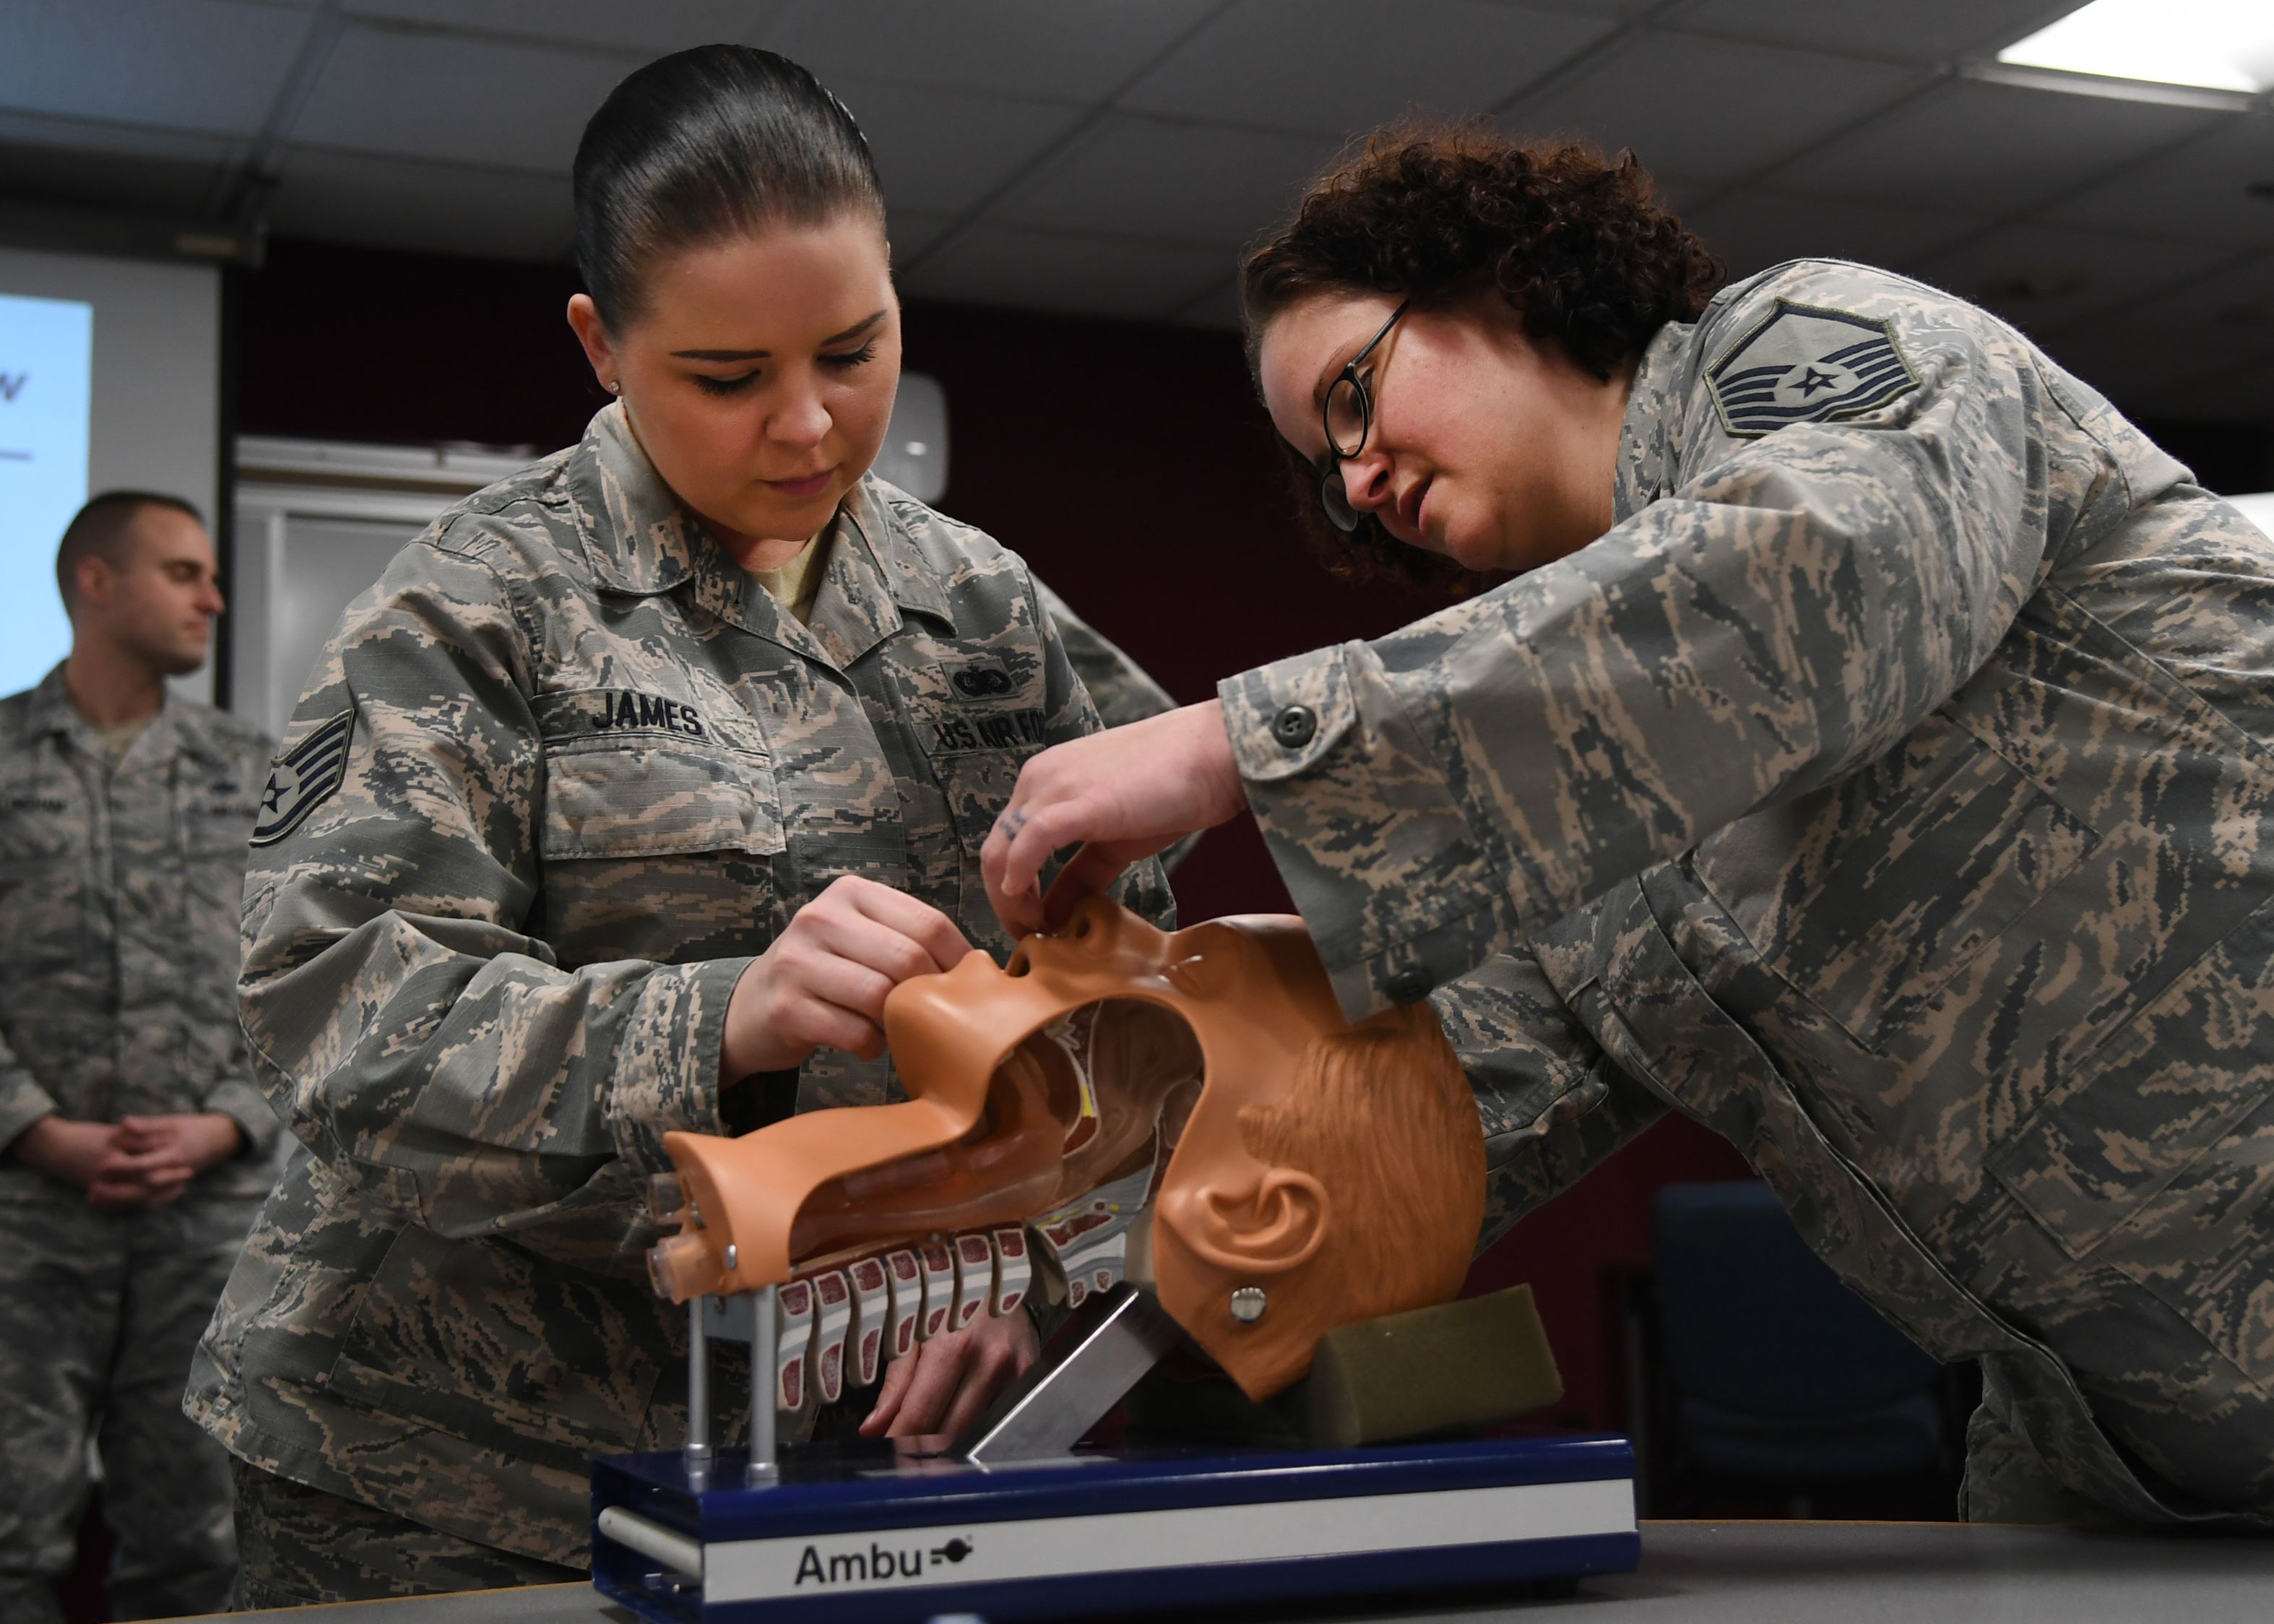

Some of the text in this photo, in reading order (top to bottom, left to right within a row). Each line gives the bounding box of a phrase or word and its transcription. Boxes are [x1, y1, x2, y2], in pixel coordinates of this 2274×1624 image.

[592, 691, 702, 735] JAMES
[977, 716, 1020, 748] AIR
[795, 1542, 922, 1585] Ambu
